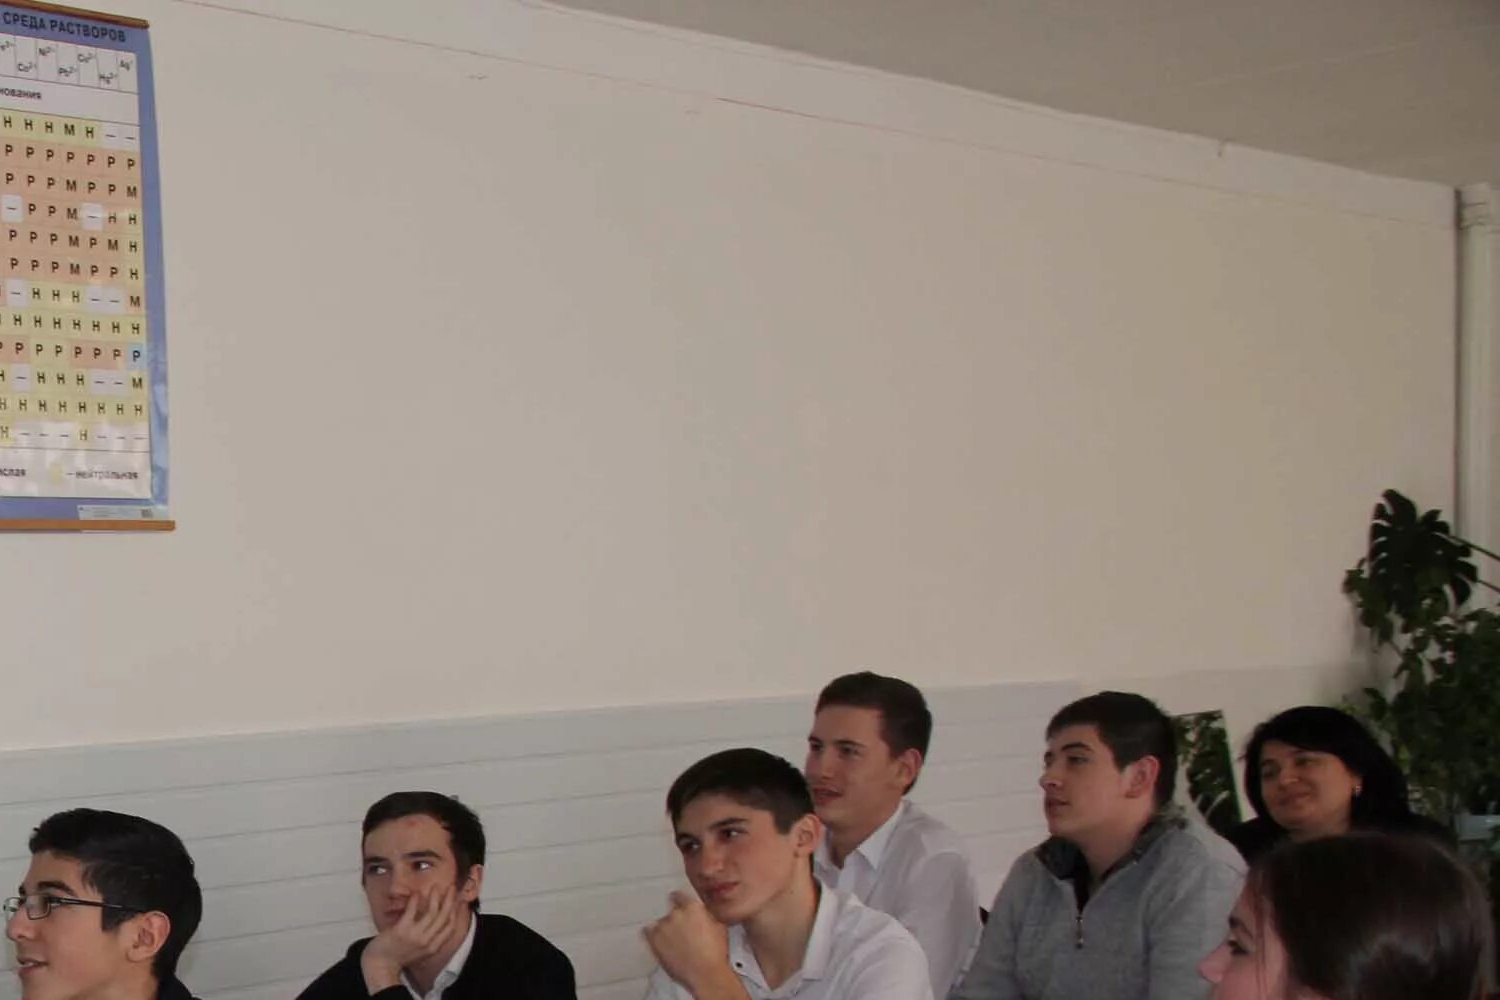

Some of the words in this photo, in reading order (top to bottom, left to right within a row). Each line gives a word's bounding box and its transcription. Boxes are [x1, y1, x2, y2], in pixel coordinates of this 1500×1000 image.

[3, 11, 47, 30] СРЕДА
[49, 20, 127, 43] РАСТВОРОВ
[4, 117, 12, 127] Н
[25, 119, 33, 130] Н
[45, 122, 53, 133] Н
[64, 124, 75, 135] М
[86, 127, 93, 138] Н
